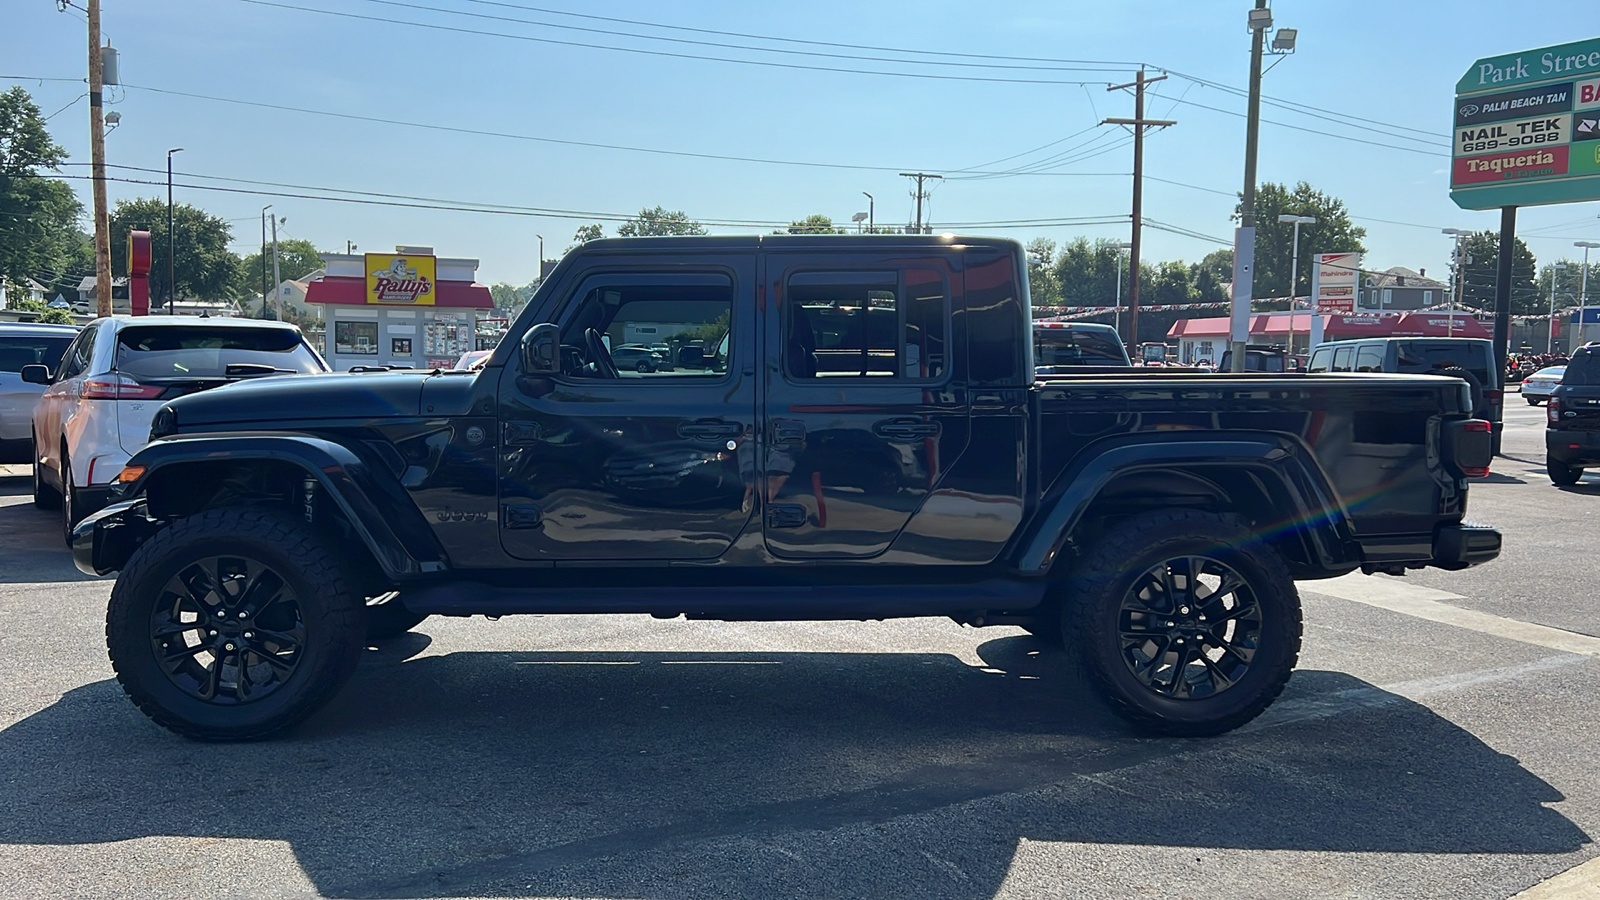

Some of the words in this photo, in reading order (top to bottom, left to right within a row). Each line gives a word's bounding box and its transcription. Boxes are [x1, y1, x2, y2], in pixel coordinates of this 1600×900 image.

[1479, 57, 1529, 85] Park
[1482, 101, 1508, 113] PALM
[1510, 95, 1543, 109] BEACH
[1546, 91, 1567, 104] TAN
[1461, 126, 1507, 143] NAIL
[1517, 118, 1561, 134] TEK
[1463, 132, 1559, 153] 689-9088
[1466, 150, 1554, 174] Taquería
[373, 276, 431, 300] Rally's
